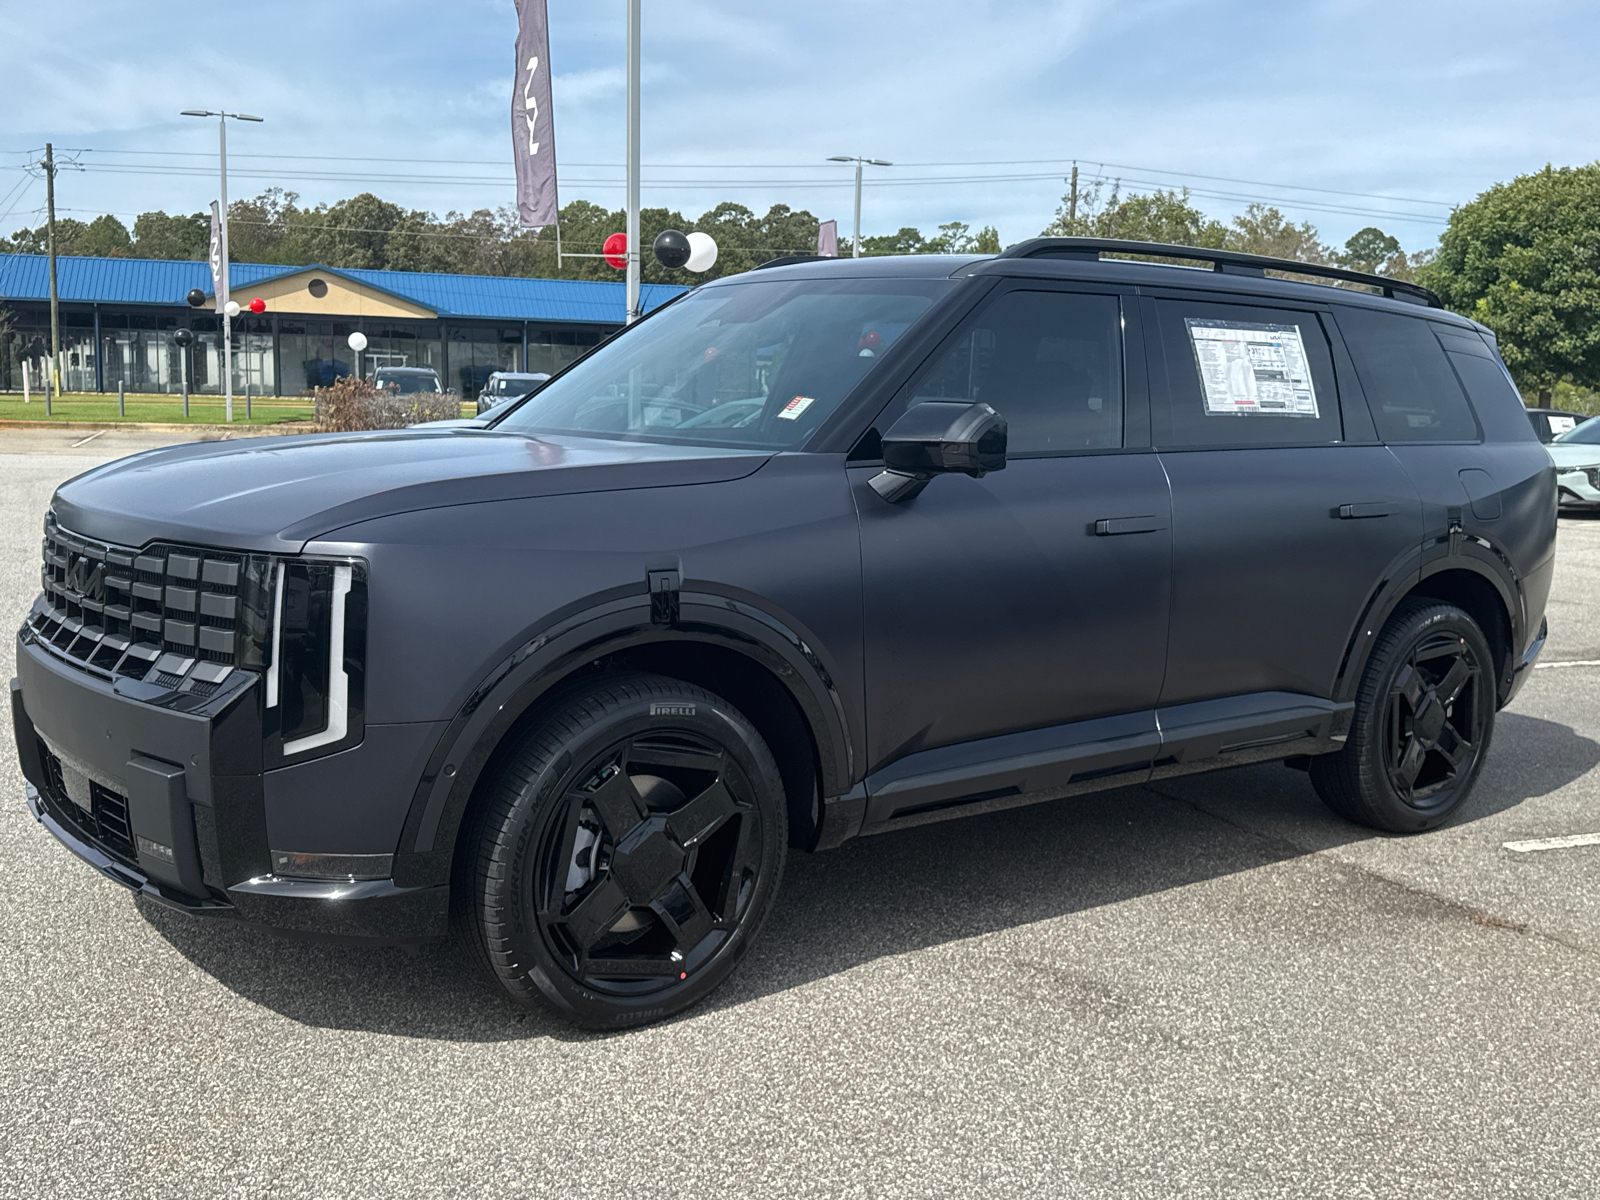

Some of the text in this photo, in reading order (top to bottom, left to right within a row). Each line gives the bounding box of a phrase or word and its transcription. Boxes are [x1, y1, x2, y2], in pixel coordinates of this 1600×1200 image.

[650, 702, 696, 716] PIRELLI
[511, 780, 550, 934] SCORPION MS
